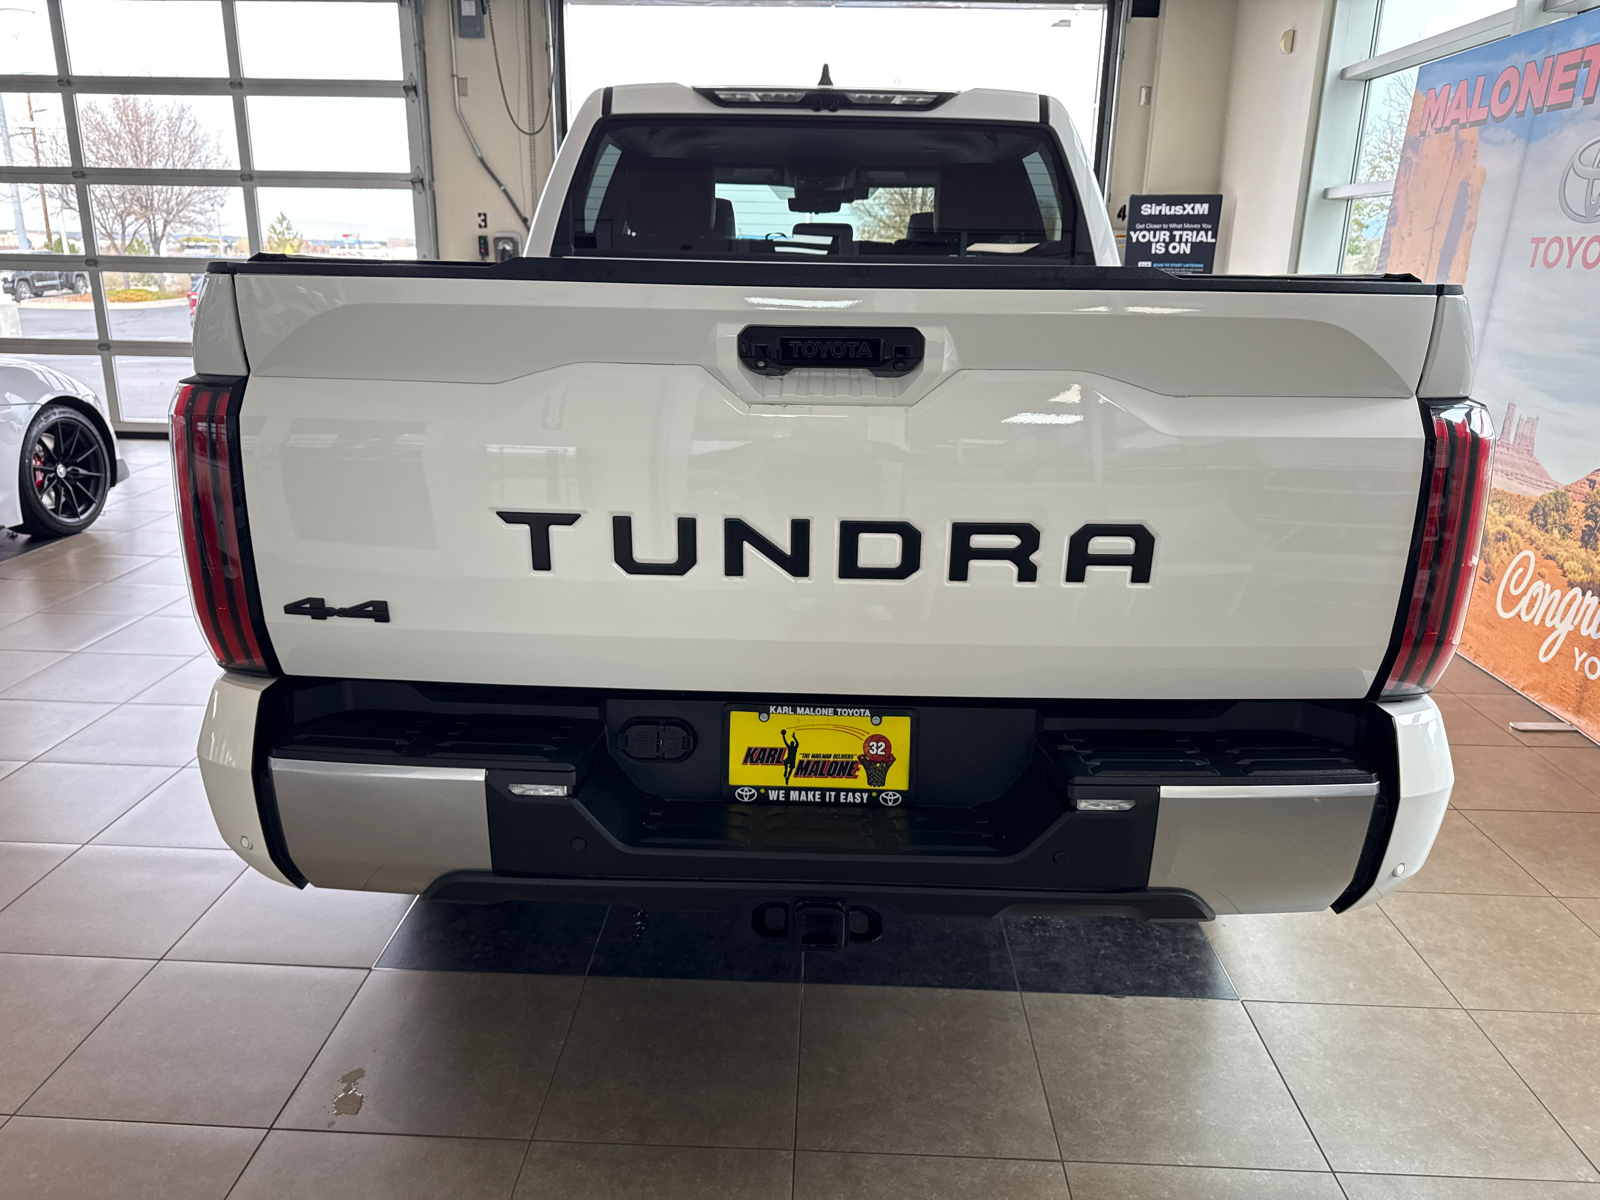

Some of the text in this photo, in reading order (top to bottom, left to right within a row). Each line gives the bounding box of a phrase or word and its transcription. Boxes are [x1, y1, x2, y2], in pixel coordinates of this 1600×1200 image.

[1117, 204, 1126, 221] 4
[1140, 203, 1209, 215] SiriusXM
[478, 213, 487, 228] 3
[1130, 231, 1216, 242] YOUR TRIAL
[1151, 243, 1191, 254] IS ON
[789, 341, 873, 358] TOYOTA
[496, 511, 1155, 583] TUNDRA
[770, 706, 871, 717] KARL MALONE TOYOTA
[869, 741, 886, 755] 32
[742, 747, 788, 766] KARL
[794, 759, 860, 779] MALONE
[769, 790, 869, 803] WE MAKE IT EASY
